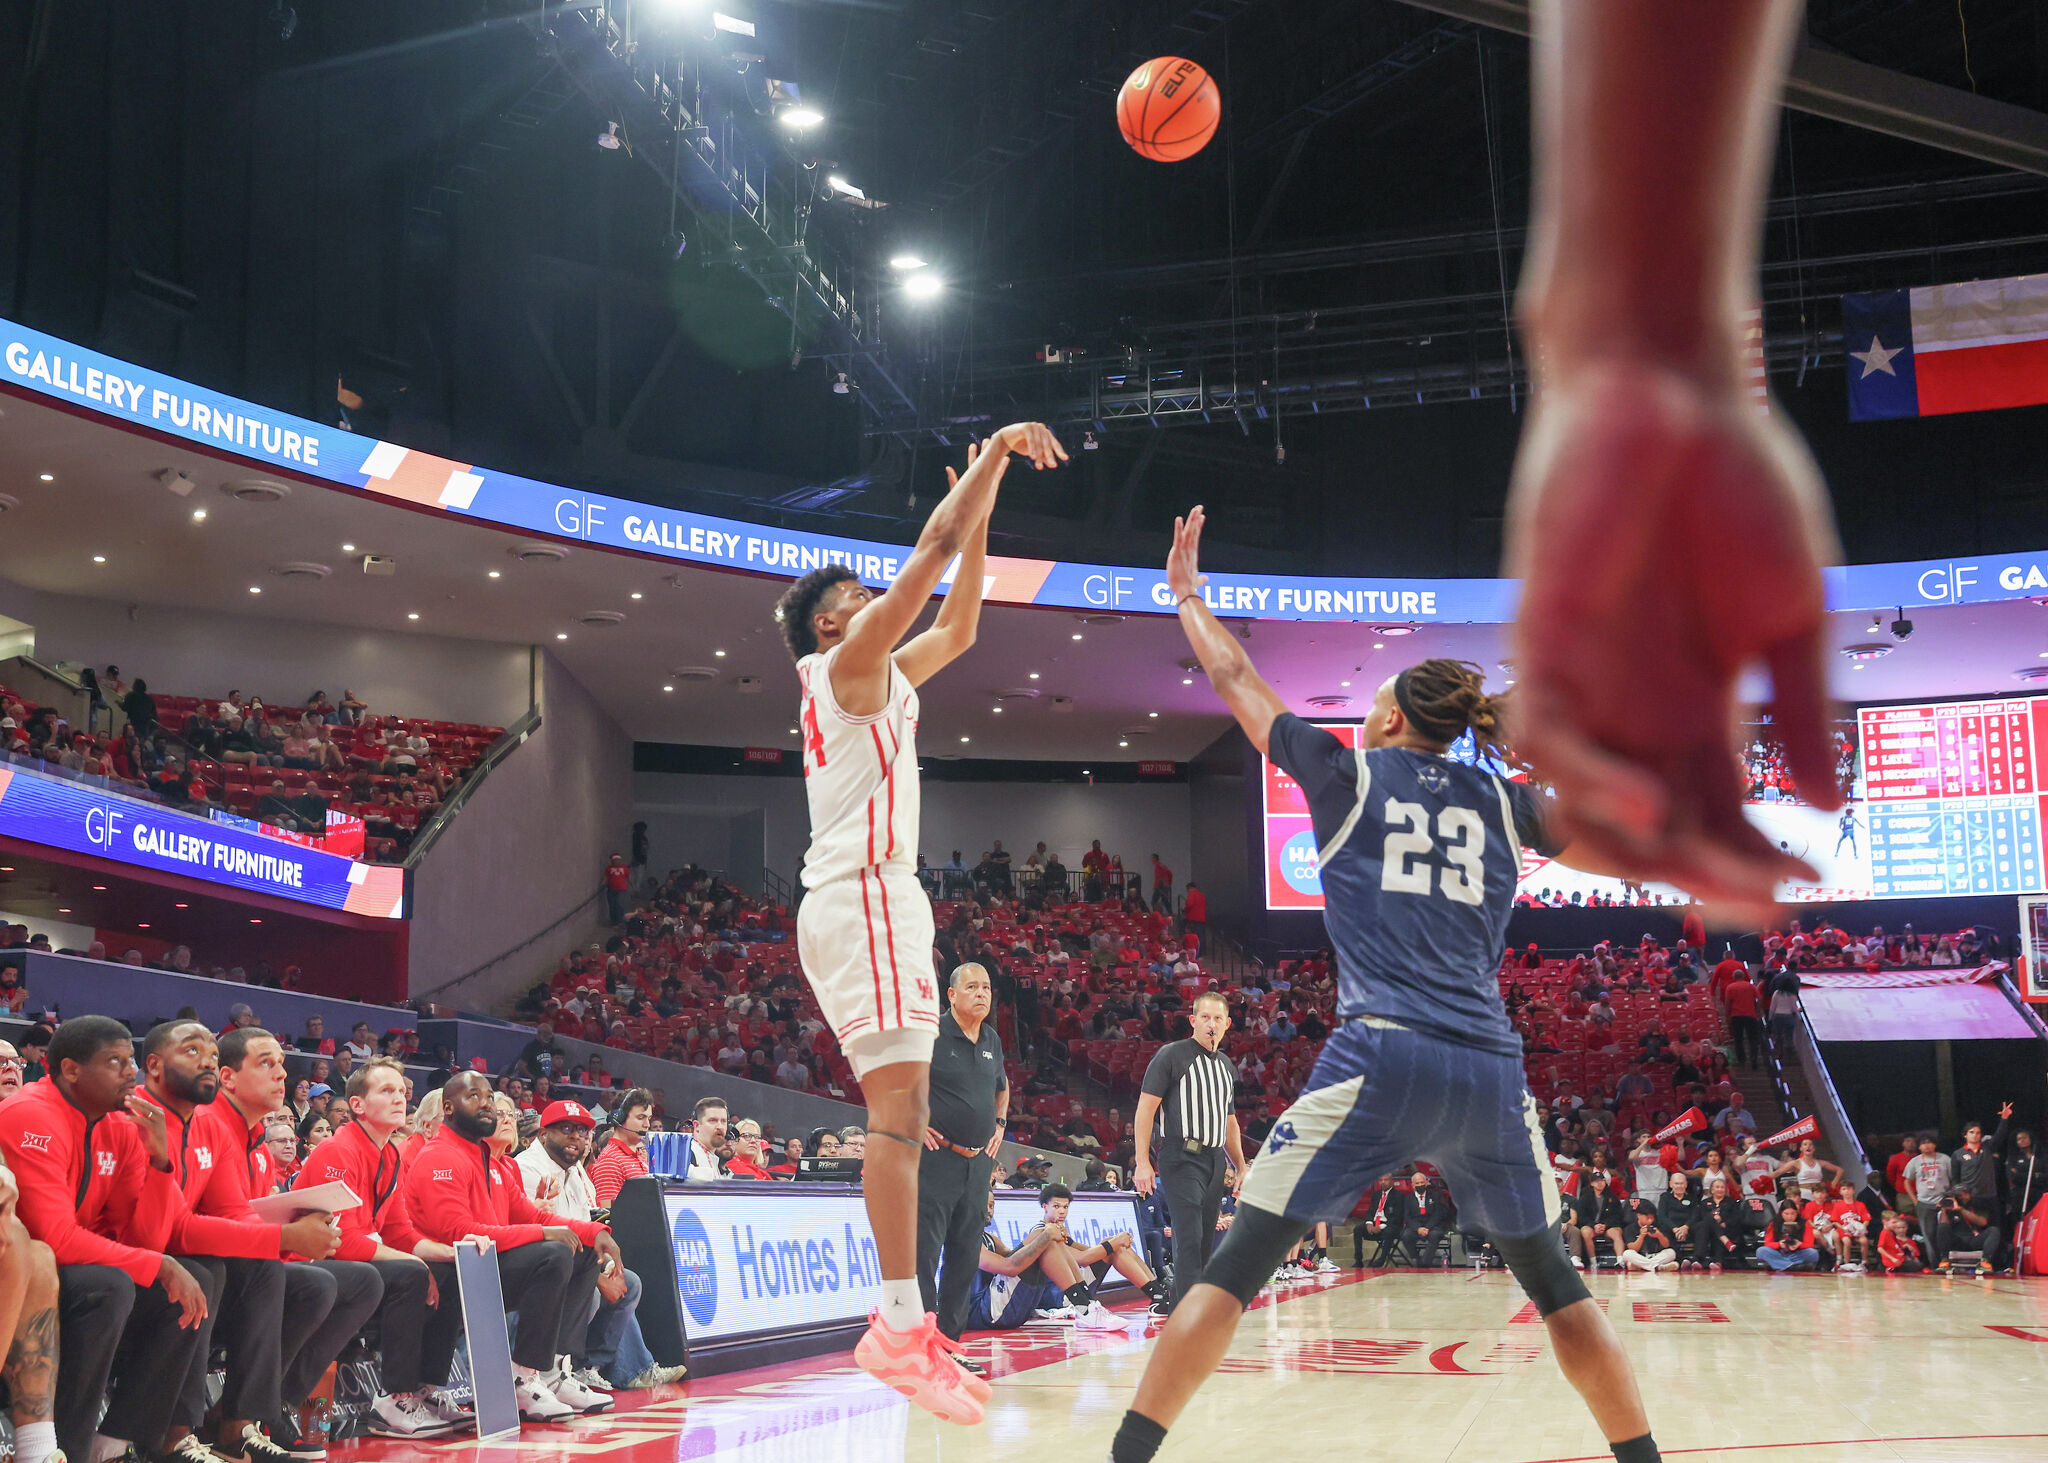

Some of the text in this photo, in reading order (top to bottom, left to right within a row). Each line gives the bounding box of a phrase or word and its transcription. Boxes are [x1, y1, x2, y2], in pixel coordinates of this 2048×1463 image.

[6, 342, 320, 466] GALLERY FURNITURE
[623, 515, 740, 558] GALLERY
[747, 537, 898, 582] FURNITURE
[1152, 582, 1271, 610] GLERY
[1278, 588, 1436, 614] FURNITURE
[1967, 718, 1976, 729] 1
[2011, 714, 2020, 726] 1
[133, 823, 211, 867] GALLERY
[214, 843, 302, 887] FURNITURE
[1288, 847, 1320, 862] HA
[1381, 796, 1485, 906] 23
[1656, 1118, 1693, 1141] COUGARS
[1768, 1123, 1814, 1146] COUGARS
[678, 1240, 710, 1267] HAR
[732, 1222, 882, 1300] Homes An
